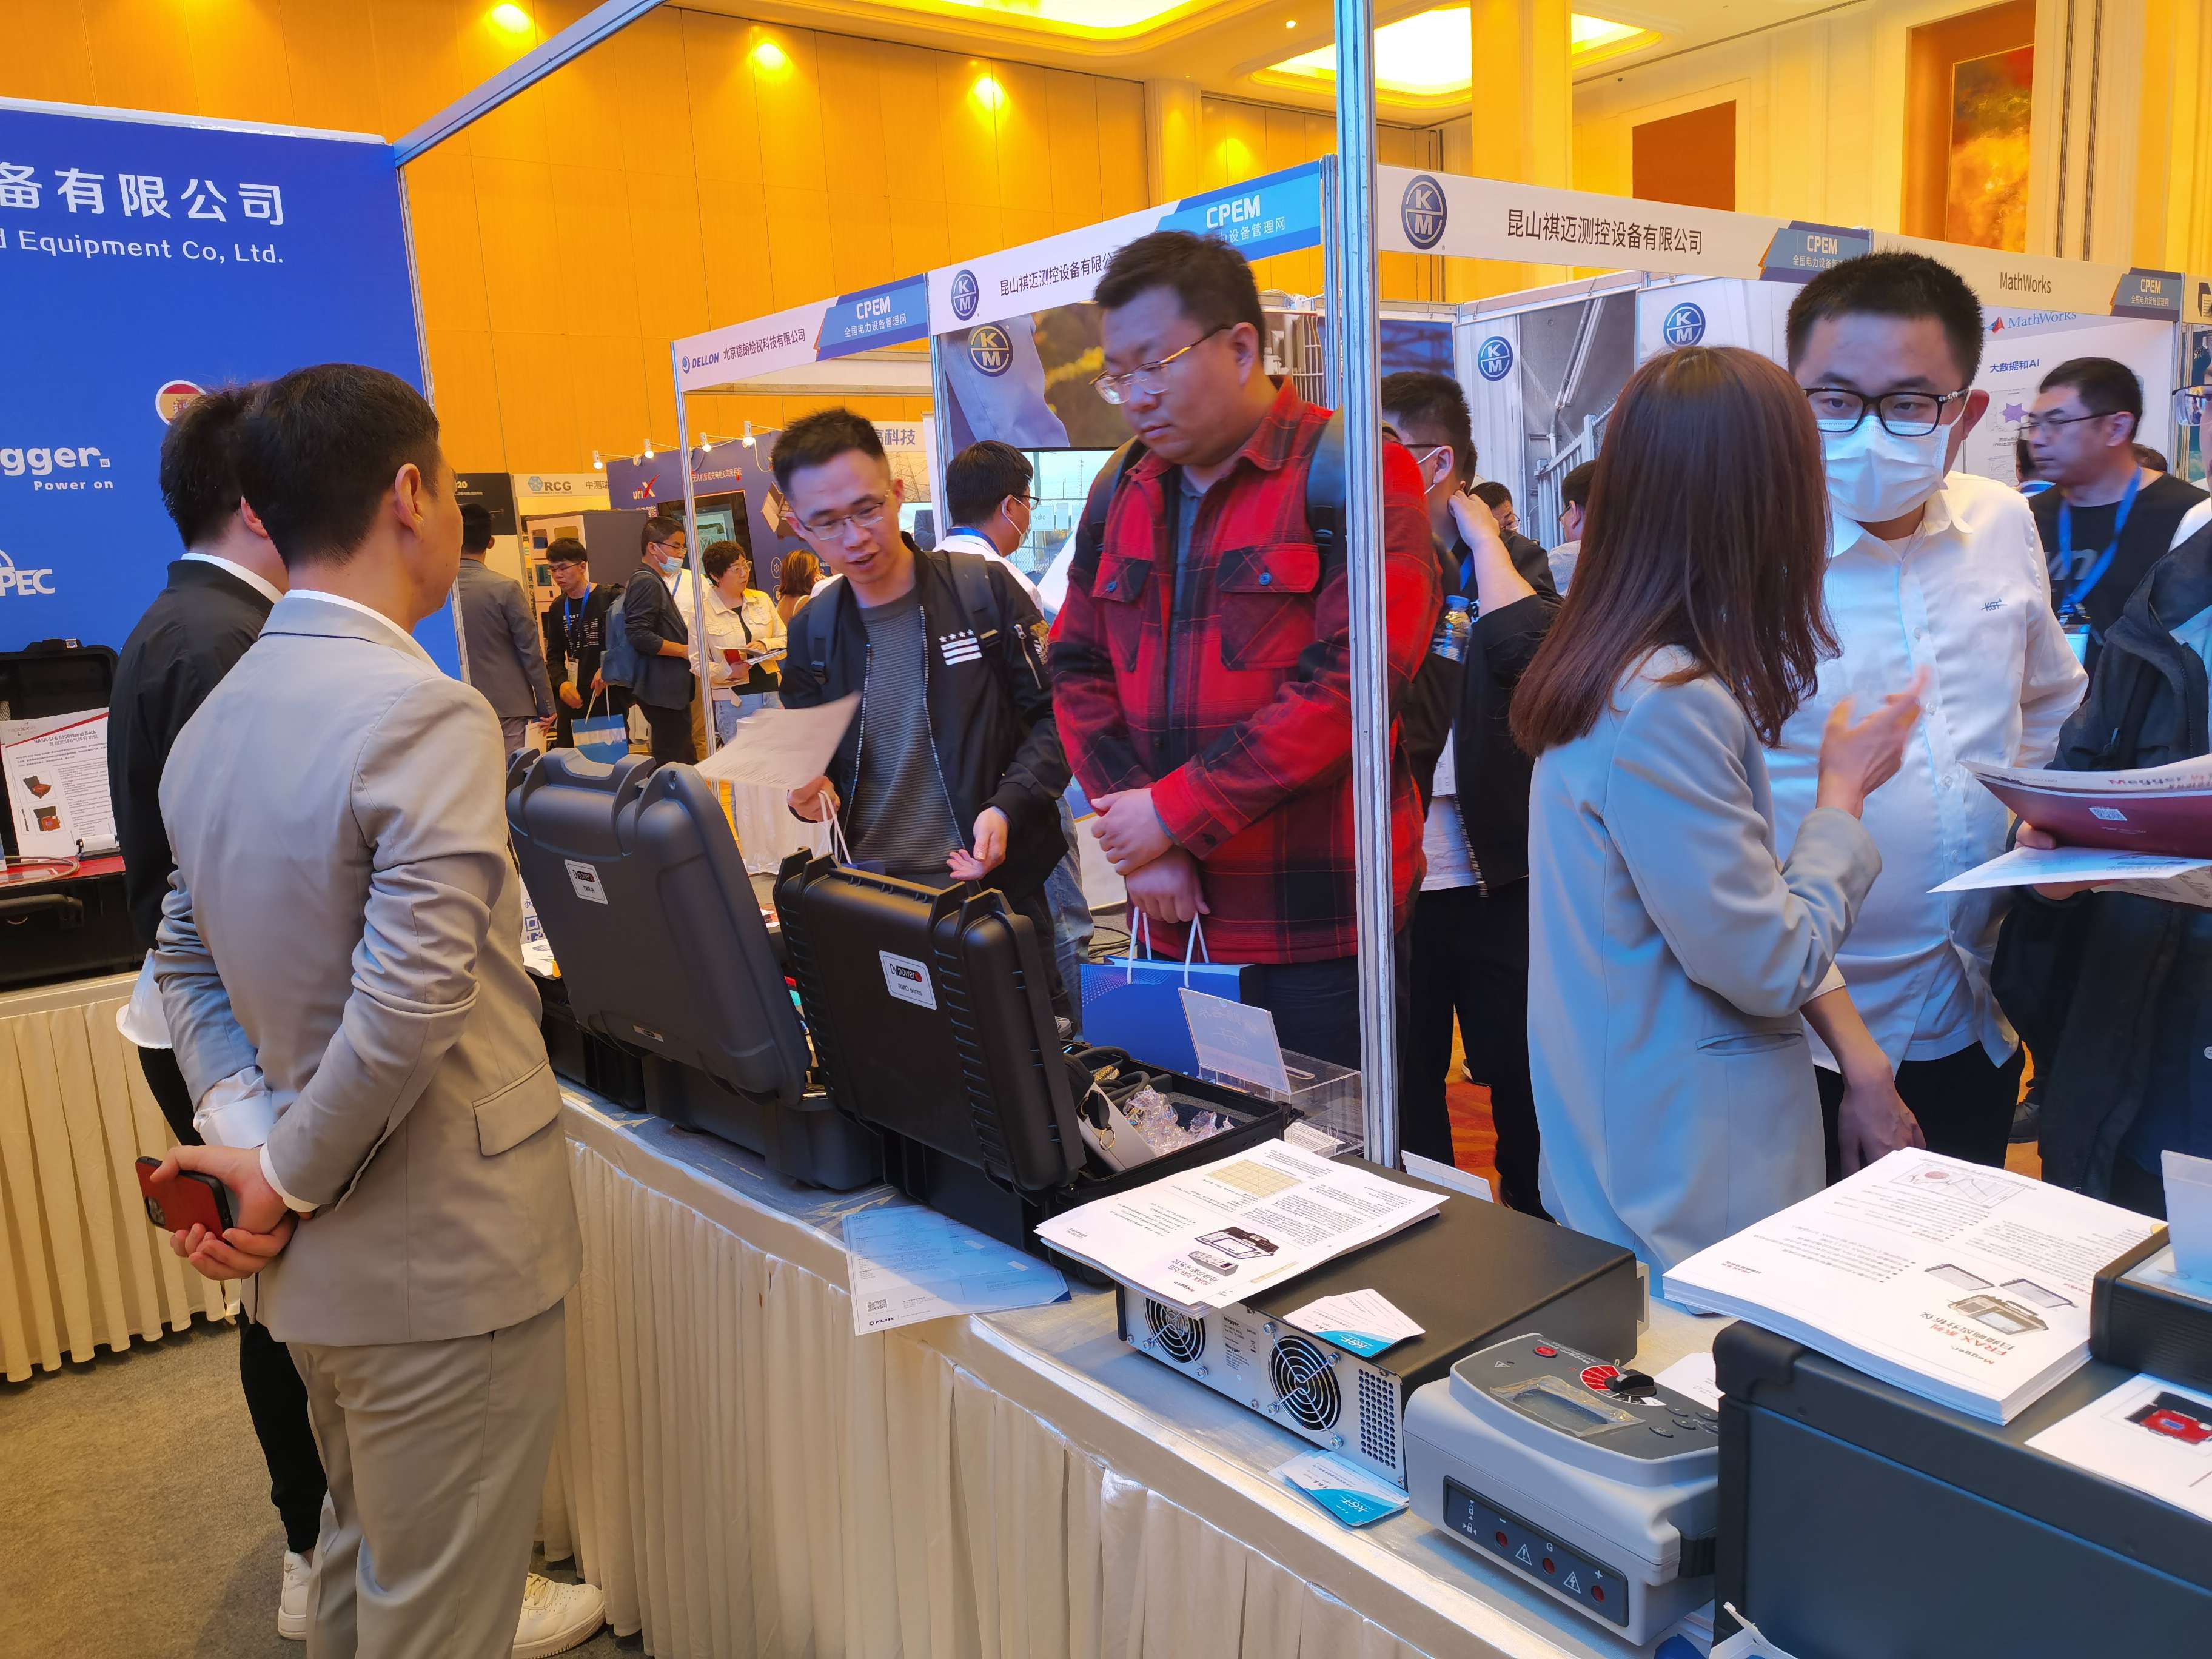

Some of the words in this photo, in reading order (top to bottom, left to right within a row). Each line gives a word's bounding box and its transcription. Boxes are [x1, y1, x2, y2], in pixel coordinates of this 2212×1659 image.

[0, 162, 284, 226] 备有限公司
[1207, 194, 1261, 229] CPEM
[1219, 216, 1285, 243] 力设备管理网
[1507, 209, 1702, 255] 昆山祺迈测控设备有限公司
[20, 231, 172, 258] Equipment
[182, 240, 224, 264] Co,
[235, 243, 284, 264] Ltd.
[1807, 235, 1838, 255] CPEM
[1000, 252, 1113, 296] 昆山祺迈测控设备有限公
[2000, 271, 2051, 294] MathWorks
[2140, 278, 2162, 295] CPEM
[856, 295, 891, 320] CPEM
[844, 313, 907, 338] 全国电力设备管理网
[2008, 311, 2077, 329] MathWorks
[723, 328, 806, 361] 北京德朗检视科技有限公司
[692, 352, 719, 369] DELLON
[1989, 358, 2040, 374] 大数据和AI
[33, 480, 86, 491] Power
[93, 480, 113, 489] on
[544, 481, 572, 491] RCG
[1032, 513, 1046, 522] hydro
[1960, 1335, 2007, 1356] FRAX
[1546, 1542, 1553, 1552] G
